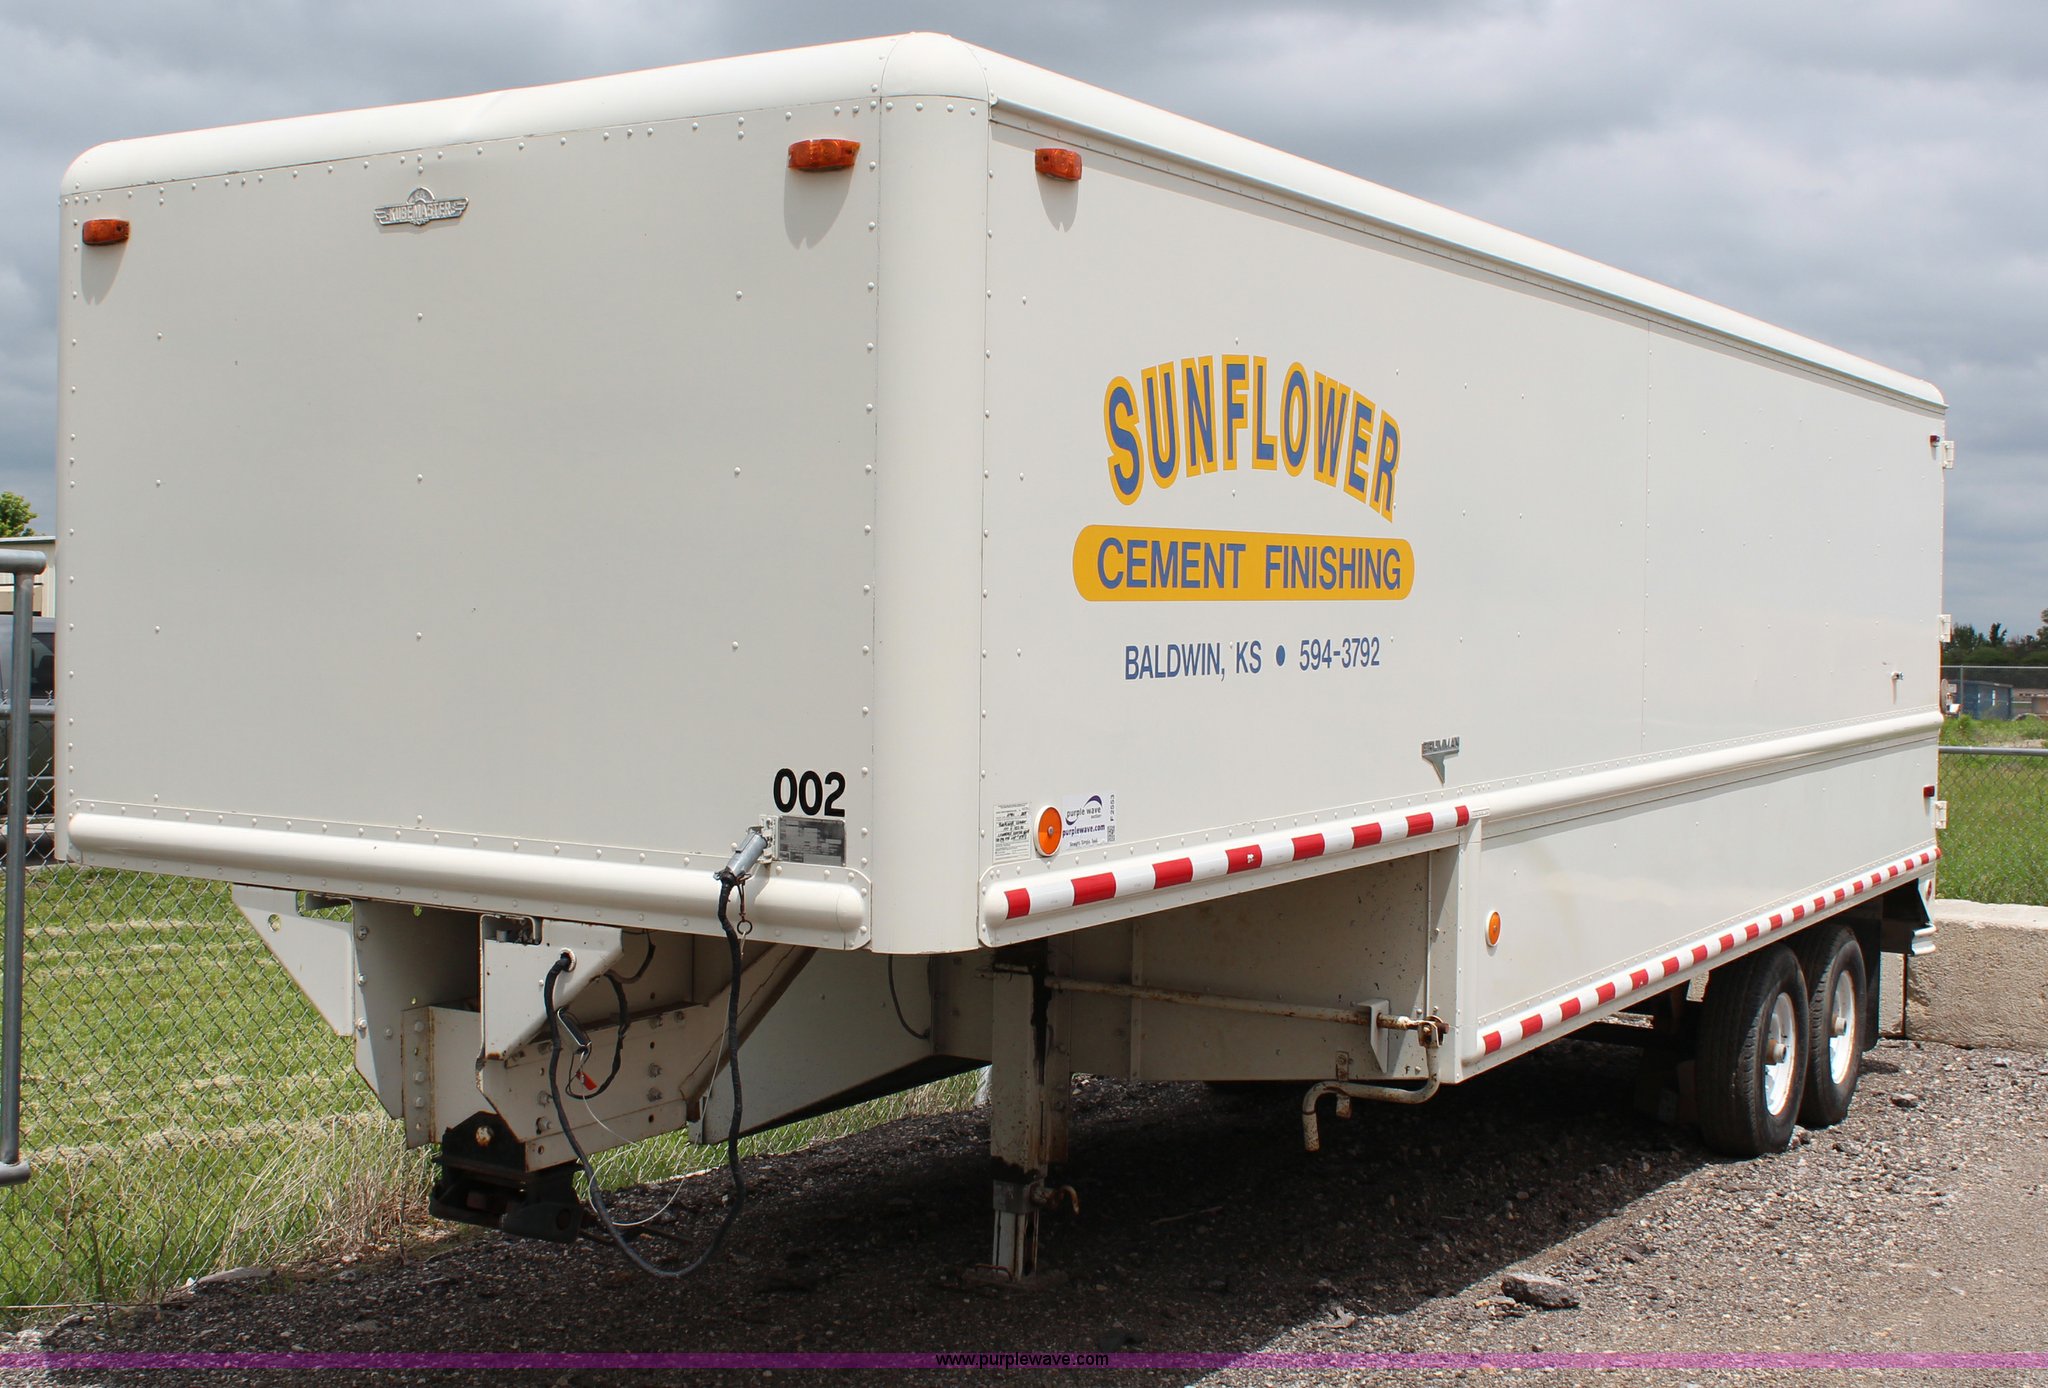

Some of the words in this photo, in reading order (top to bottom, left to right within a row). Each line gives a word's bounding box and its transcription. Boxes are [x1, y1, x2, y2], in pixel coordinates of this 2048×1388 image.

[1104, 354, 1400, 523] SUNFLOWER
[1097, 537, 1246, 589] CEMENT
[1265, 544, 1400, 590] FINISHING
[1125, 642, 1226, 682] BALDWIN,
[1235, 641, 1262, 674] KS
[1299, 637, 1380, 671] 594-3792
[773, 768, 845, 817] 002
[1066, 807, 1085, 818] purple
[1086, 806, 1101, 815] wave
[1062, 824, 1105, 838] purplewave.com
